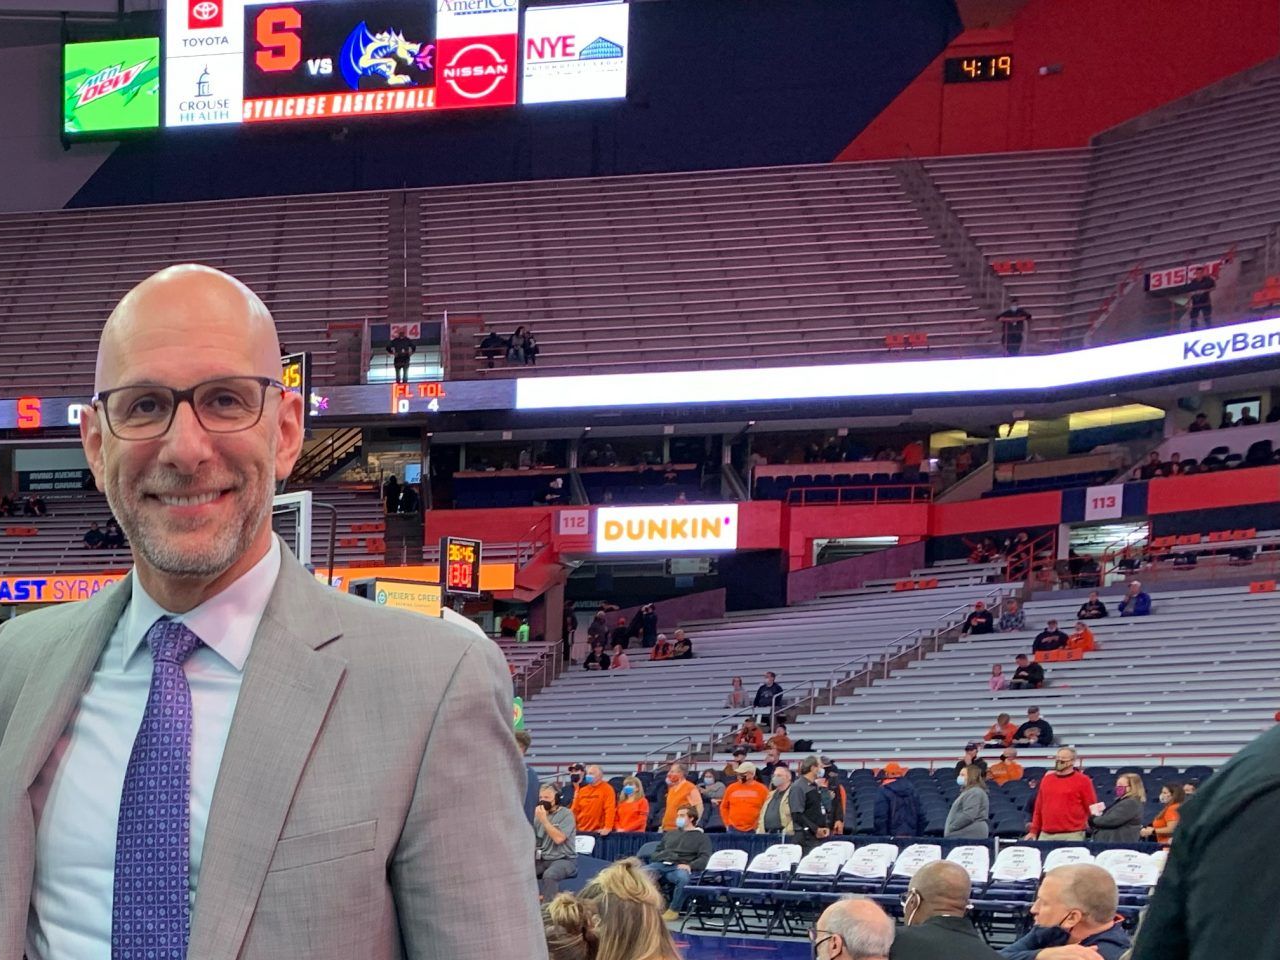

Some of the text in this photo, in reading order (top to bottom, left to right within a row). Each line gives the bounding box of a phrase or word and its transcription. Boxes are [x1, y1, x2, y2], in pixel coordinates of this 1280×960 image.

[182, 36, 229, 47] TOYOTA
[256, 7, 301, 71] S
[526, 34, 576, 60] NYE
[443, 64, 508, 78] NISSAN
[963, 56, 1011, 78] 4:19
[179, 99, 230, 111] CROUSE
[243, 89, 435, 119] SYRACUSE BASKETBALL
[180, 111, 230, 122] HEALTH
[1151, 269, 1186, 289] 315
[391, 323, 420, 338] 34
[396, 384, 446, 398] FL TOL
[18, 397, 42, 429] S
[398, 399, 439, 413] 0 4
[1092, 496, 1116, 509] 113
[563, 516, 586, 528] 112
[604, 516, 730, 541] DUNKIN'
